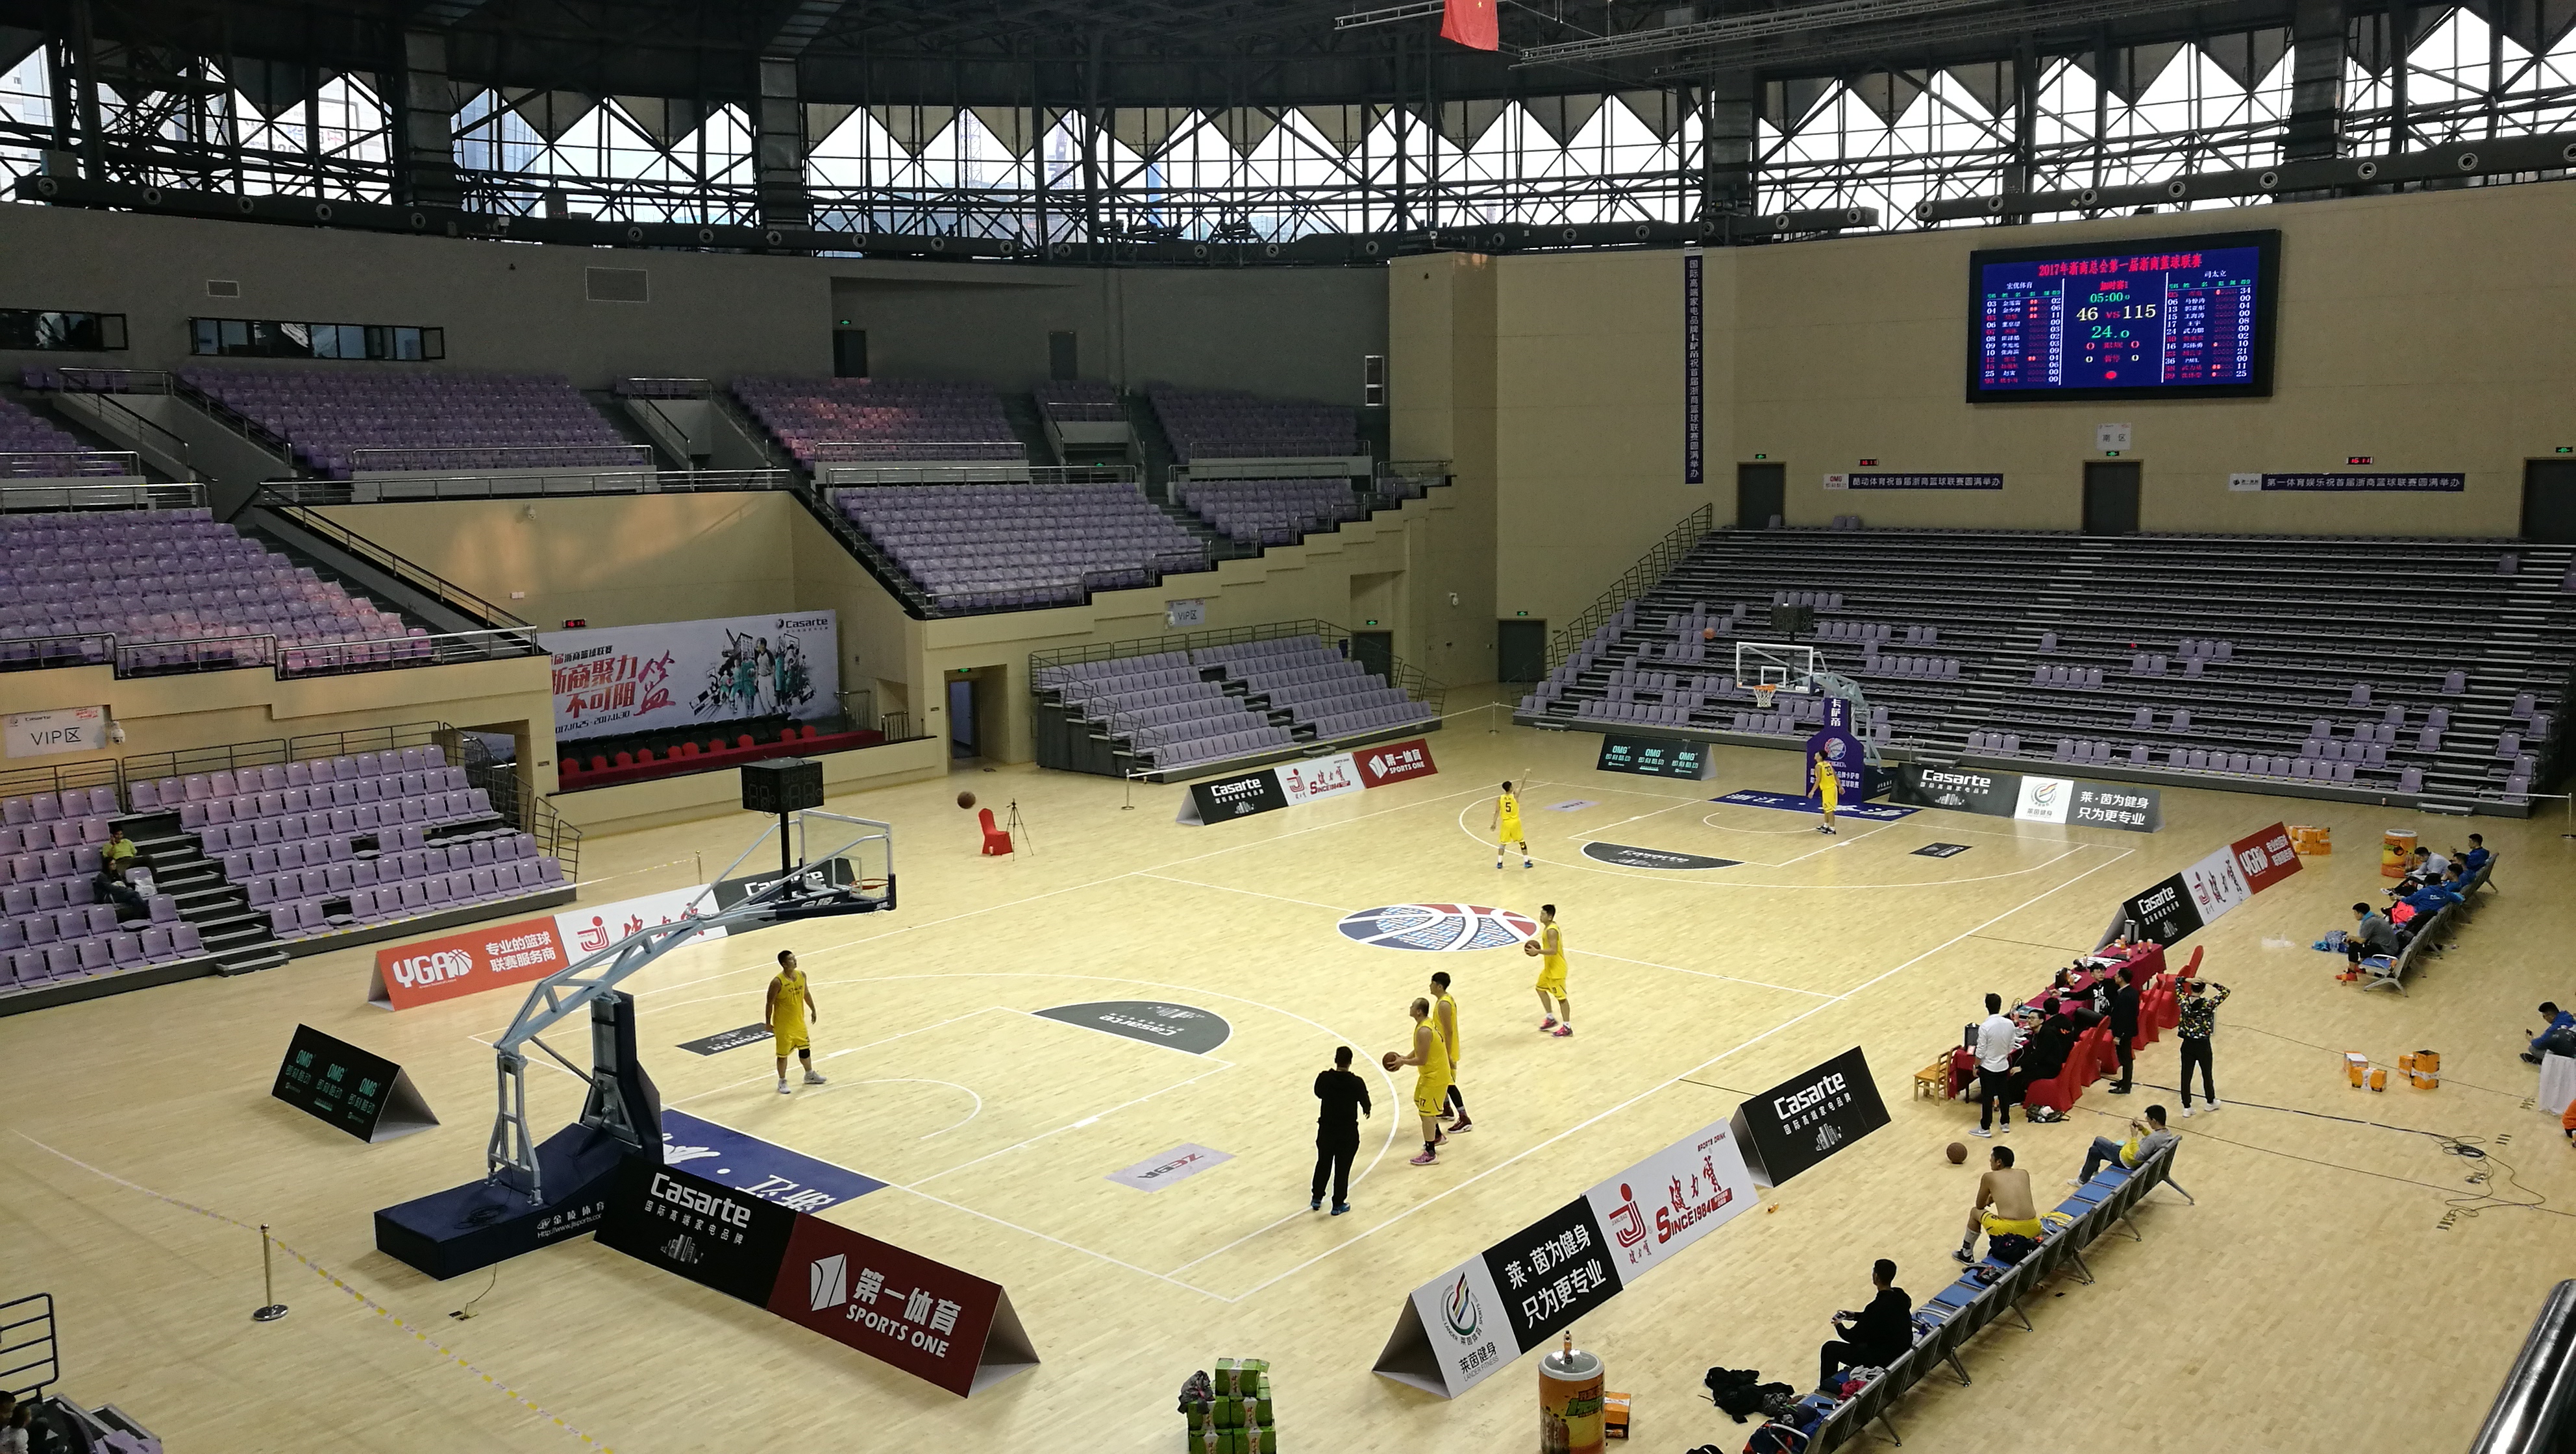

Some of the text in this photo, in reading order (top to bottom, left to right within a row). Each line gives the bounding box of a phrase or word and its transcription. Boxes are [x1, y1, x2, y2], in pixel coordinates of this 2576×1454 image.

[2076, 307, 2098, 321] 46
[2124, 304, 2156, 319] 115
[1853, 477, 2000, 486] 酷动体育祝首届浙商篮球联赛圆满举办
[2267, 478, 2460, 487] 第一体育娱乐祝首届浙商篮球联赛圆满举办
[786, 619, 828, 628] Casarte
[1178, 610, 1197, 621] VIP区
[565, 682, 636, 719] 不可阻
[1831, 698, 1842, 726] 卡萨帝
[31, 727, 81, 746] VIP区
[1384, 748, 1422, 767] 第一体育
[1613, 745, 1628, 754] OMG
[1645, 748, 1661, 757] OMG
[1679, 752, 1695, 761] OMG
[1389, 764, 1411, 774] SPORTS
[1922, 770, 1991, 787] Casarte
[1211, 778, 1262, 797] Casarte
[1505, 802, 1511, 813] 5
[2077, 807, 2146, 826] 只为更专业
[2138, 887, 2175, 915] Casarte
[486, 931, 552, 956] 专业的篮球
[489, 947, 556, 972] 联赛服务商
[392, 952, 456, 988] YGA
[1099, 1015, 1177, 1036] Casarte
[296, 1050, 314, 1068] OMG
[327, 1063, 345, 1083] OMG
[359, 1078, 378, 1097] OMG
[1774, 1072, 1846, 1120] Casarte
[1783, 1092, 1852, 1135] 国际高端家电品牌
[650, 1172, 751, 1229] Casarte
[554, 1201, 604, 1225] 金陵体育
[645, 1200, 744, 1245] 国际高端家电品牌
[853, 1268, 962, 1336] 第一体育
[1522, 1258, 1606, 1329] 只为更专业
[847, 1304, 950, 1359] SPORTS ONE
[1459, 1342, 1497, 1375] 莱茵健身
[1463, 1356, 1500, 1382] LANDER FITNESS
